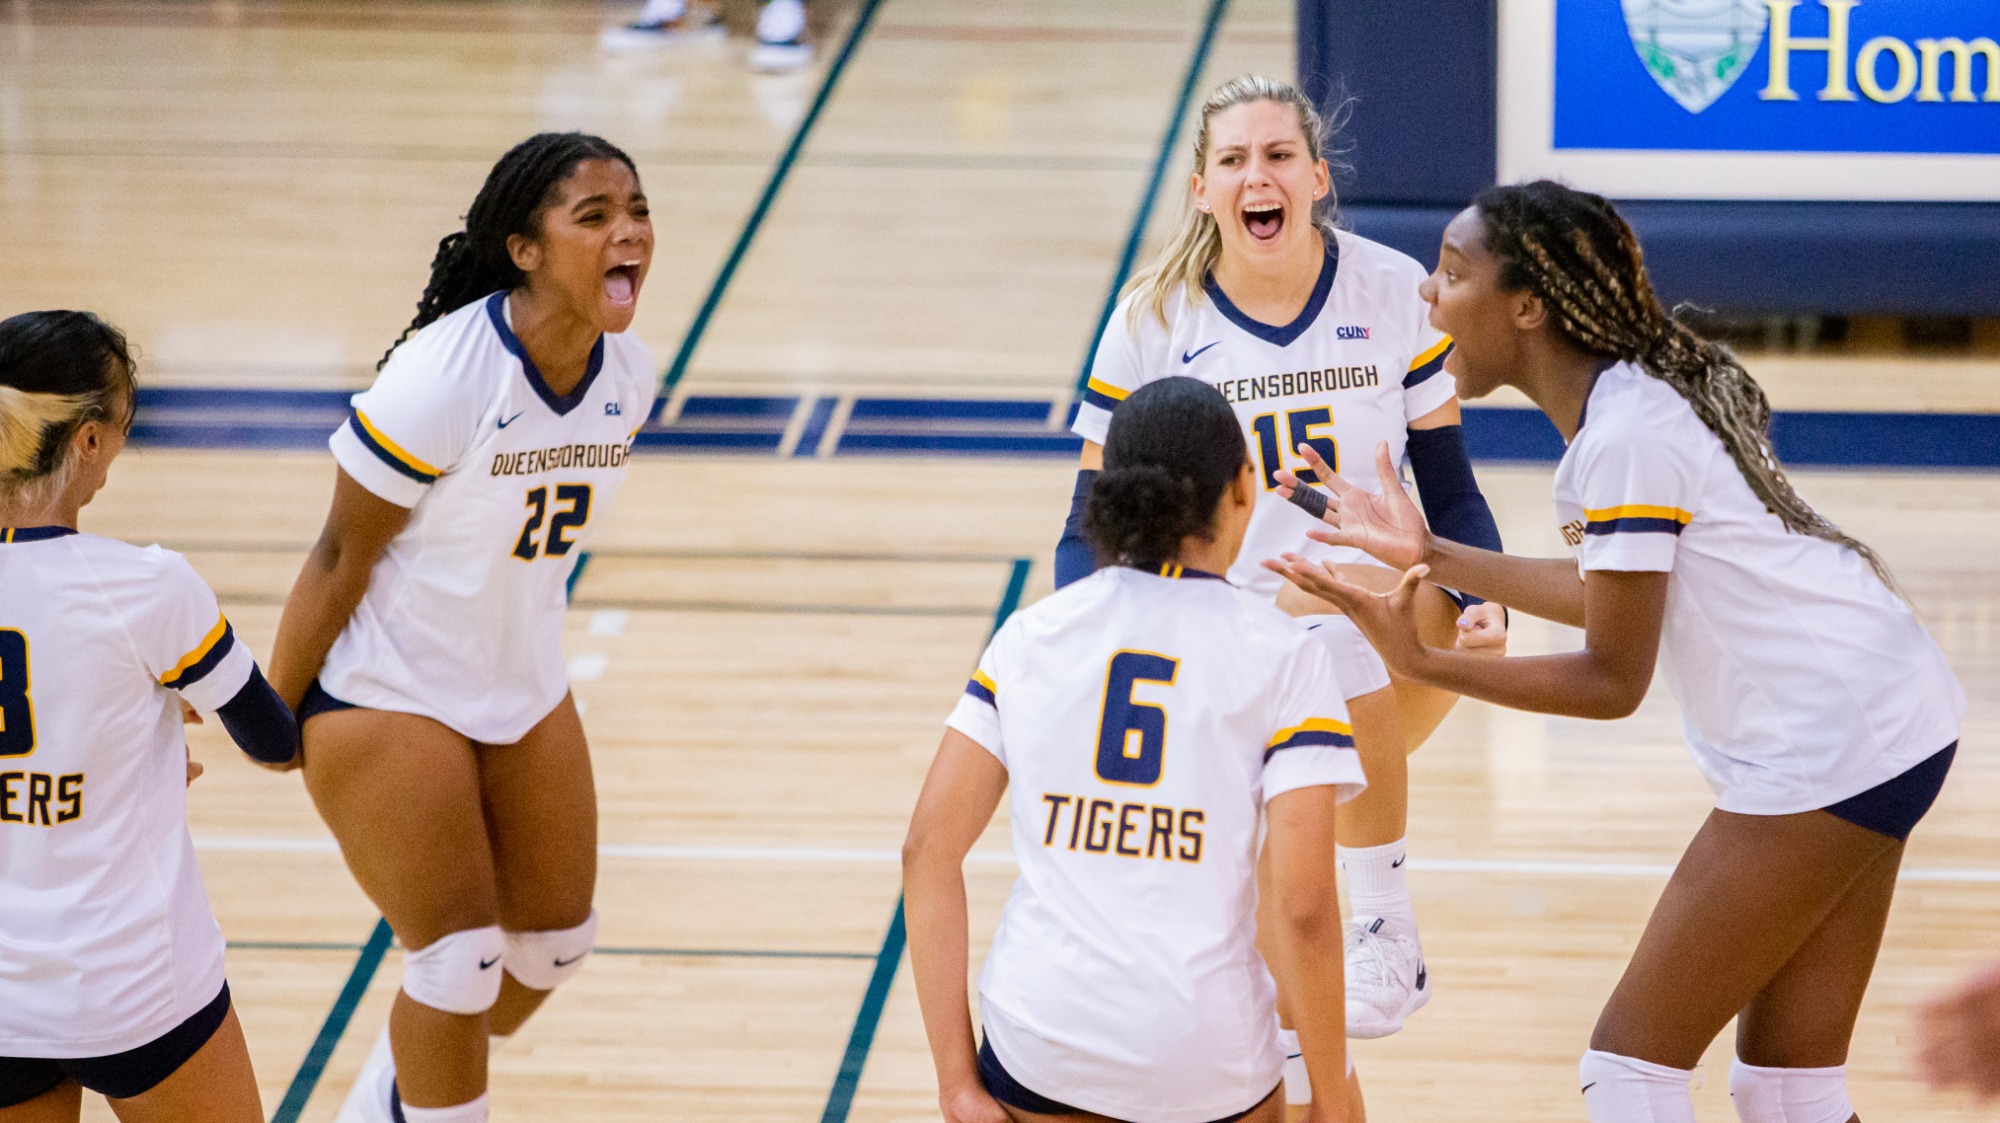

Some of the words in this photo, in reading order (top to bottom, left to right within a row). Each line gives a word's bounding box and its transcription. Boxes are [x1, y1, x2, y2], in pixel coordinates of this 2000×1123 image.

[1758, 0, 2000, 103] Hom
[1336, 326, 1370, 340] CUNY
[1210, 364, 1379, 403] EENSBOROUGH
[1251, 405, 1340, 493] 15
[511, 482, 593, 563] 22
[1093, 648, 1181, 788] 6
[1042, 792, 1205, 863] TIGERS
